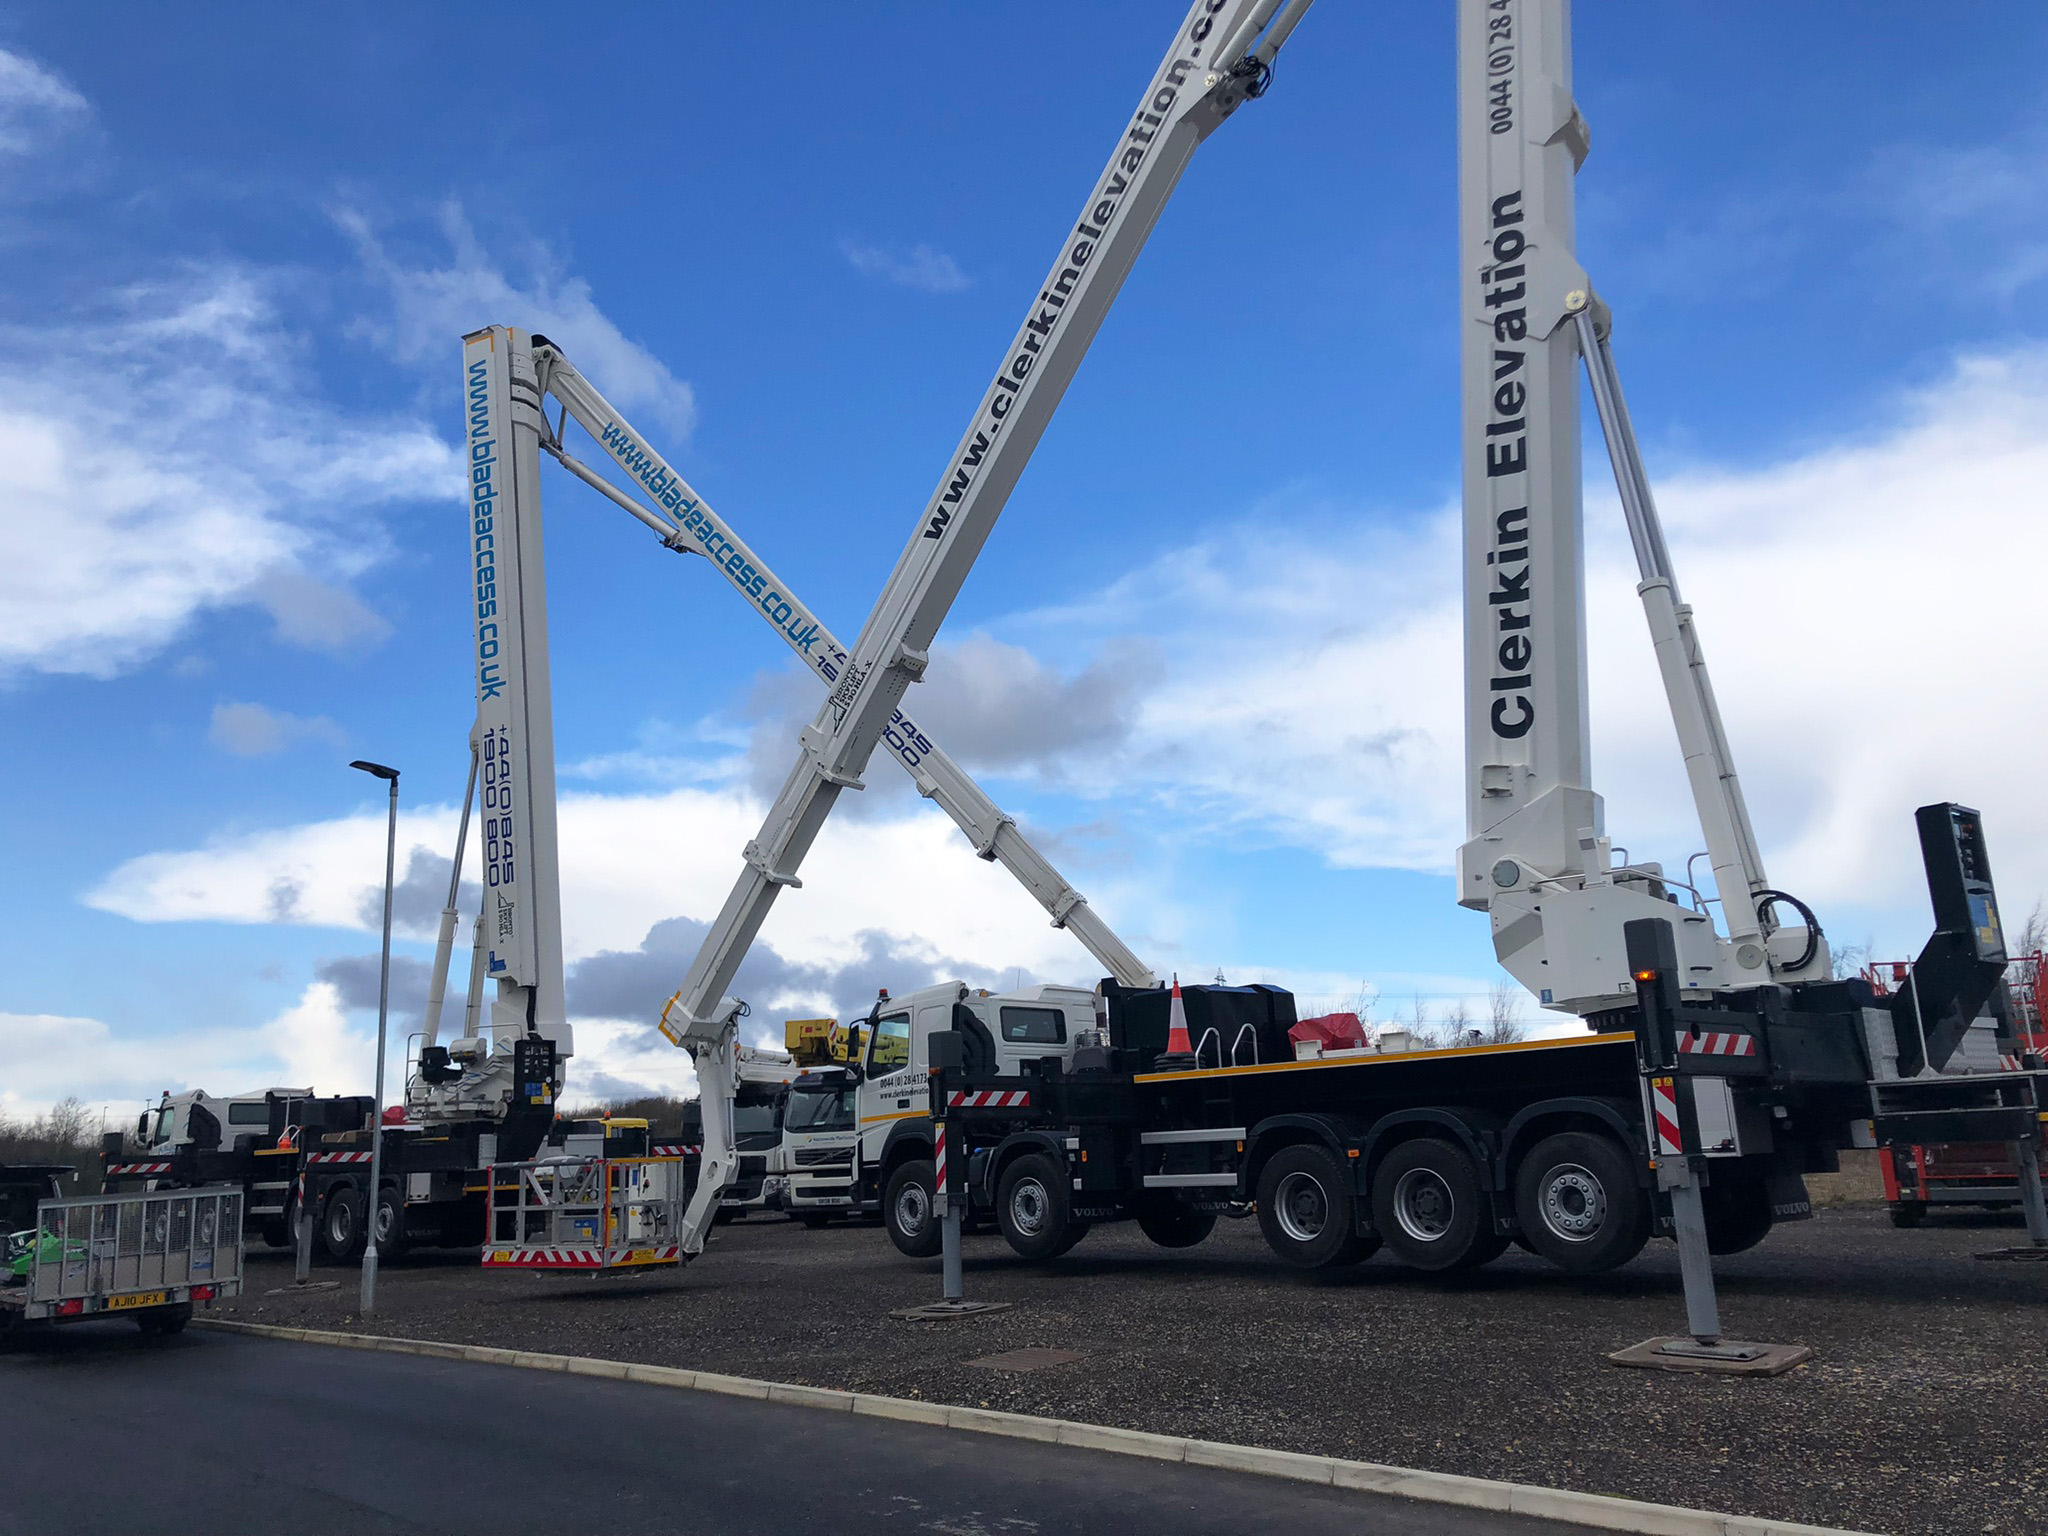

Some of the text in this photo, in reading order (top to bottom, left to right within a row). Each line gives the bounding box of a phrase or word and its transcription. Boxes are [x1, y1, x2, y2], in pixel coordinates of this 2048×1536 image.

[1490, 79, 1513, 135] 0044
[1482, 190, 1535, 740] Clerkin Elevation
[469, 359, 506, 702] www.bladeaccess.co.uk
[601, 422, 820, 655] www.bladeaccess.co.uk
[833, 663, 857, 701] BRONTO
[838, 667, 861, 704] SKYLIFT
[484, 727, 500, 887] 1900 800
[498, 724, 515, 885] +44(0)845
[880, 1077, 894, 1089] 0044
[1073, 1207, 1114, 1217] VOLVO
[1192, 1201, 1229, 1211] VOLVO
[1774, 1202, 1809, 1215] VOLVO
[406, 1228, 441, 1237] VOLVO
[113, 1292, 159, 1307] AJ10 JFX
